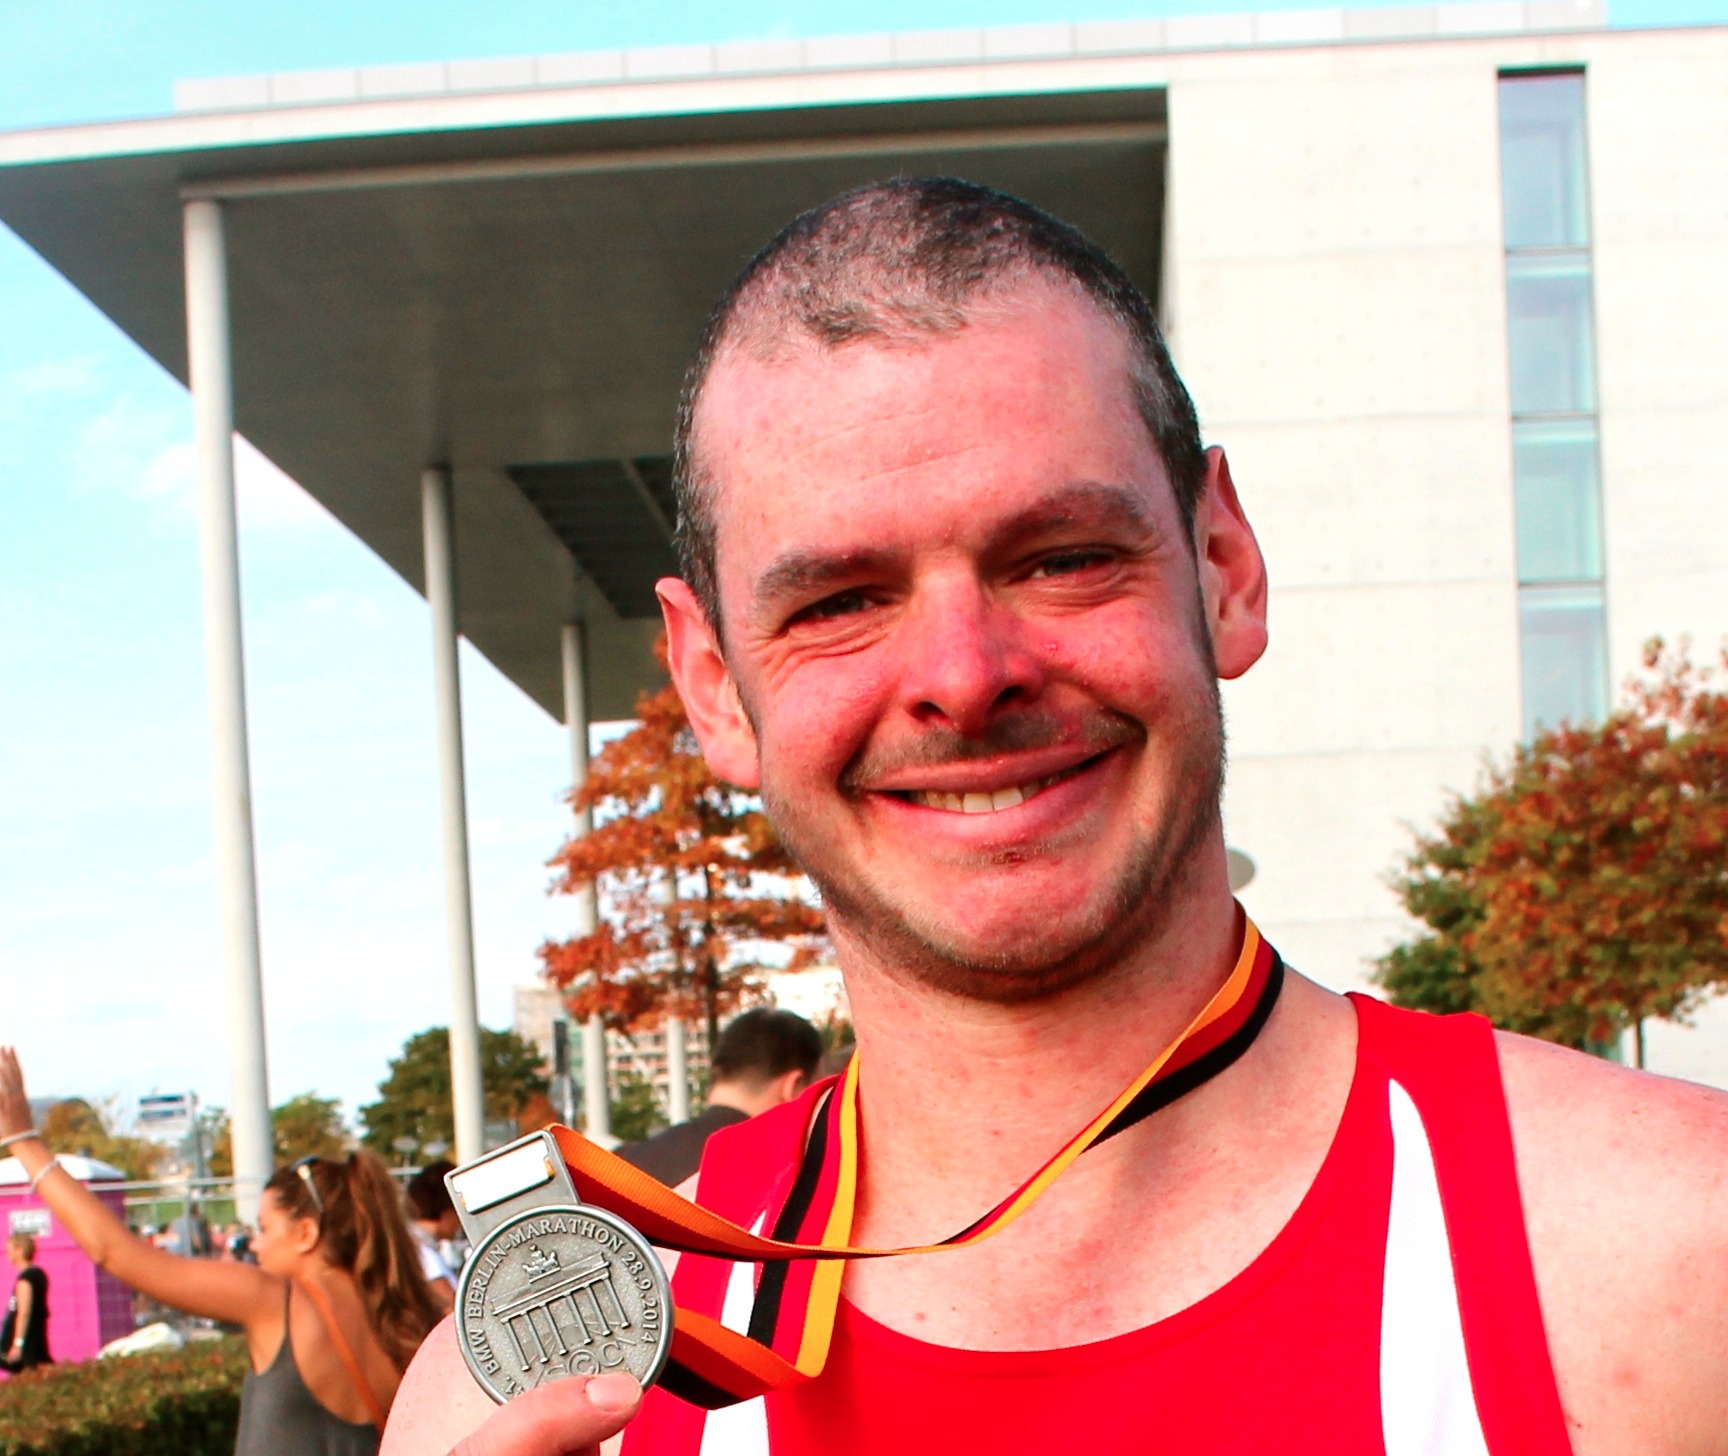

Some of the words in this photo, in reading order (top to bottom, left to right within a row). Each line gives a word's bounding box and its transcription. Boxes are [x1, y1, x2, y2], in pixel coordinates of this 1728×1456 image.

[468, 1217, 624, 1319] BERLIN-MARATHON
[622, 1251, 659, 1344] 28.9.2014
[469, 1328, 500, 1376] BMW
